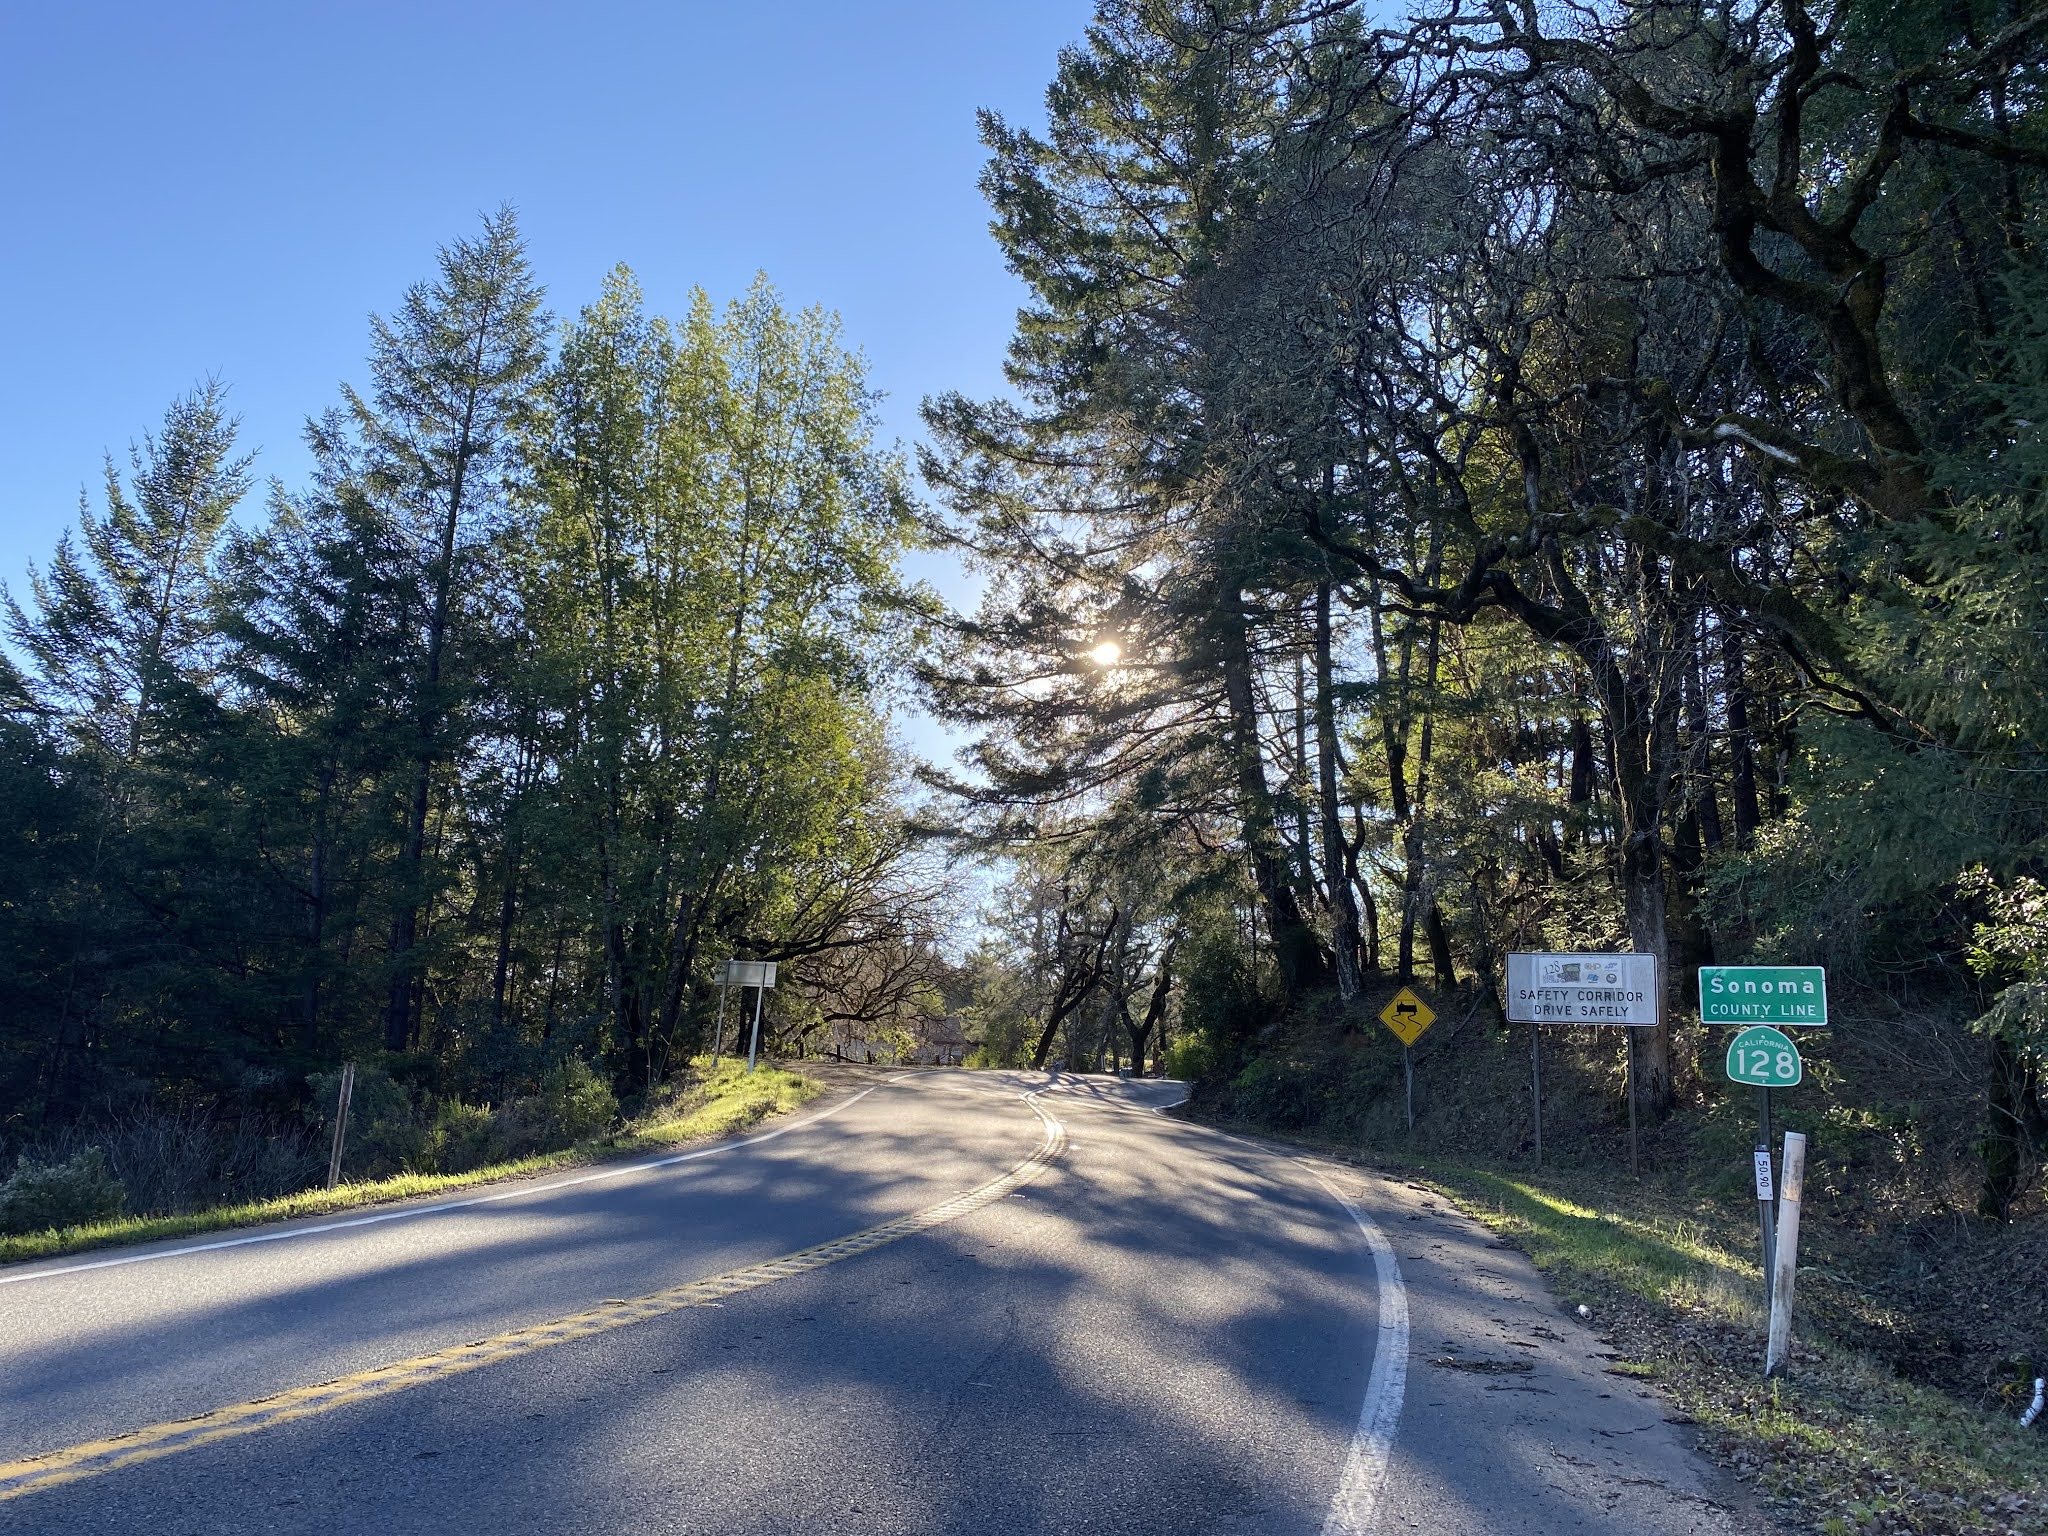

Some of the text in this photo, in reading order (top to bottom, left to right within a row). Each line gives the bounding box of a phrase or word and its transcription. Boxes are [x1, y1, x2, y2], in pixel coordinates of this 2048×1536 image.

[1544, 960, 1561, 975] 128
[1710, 977, 1815, 994] Sonoma
[1520, 989, 1643, 1002] SAFETY CORRIDOR
[1534, 1004, 1629, 1017] DRIVE SAFELY
[1710, 1004, 1817, 1016] COUNTY LINE
[1738, 1039, 1789, 1051] CALIFORNIA
[1737, 1049, 1795, 1079] 128
[1758, 1160, 1770, 1188] 50.90
